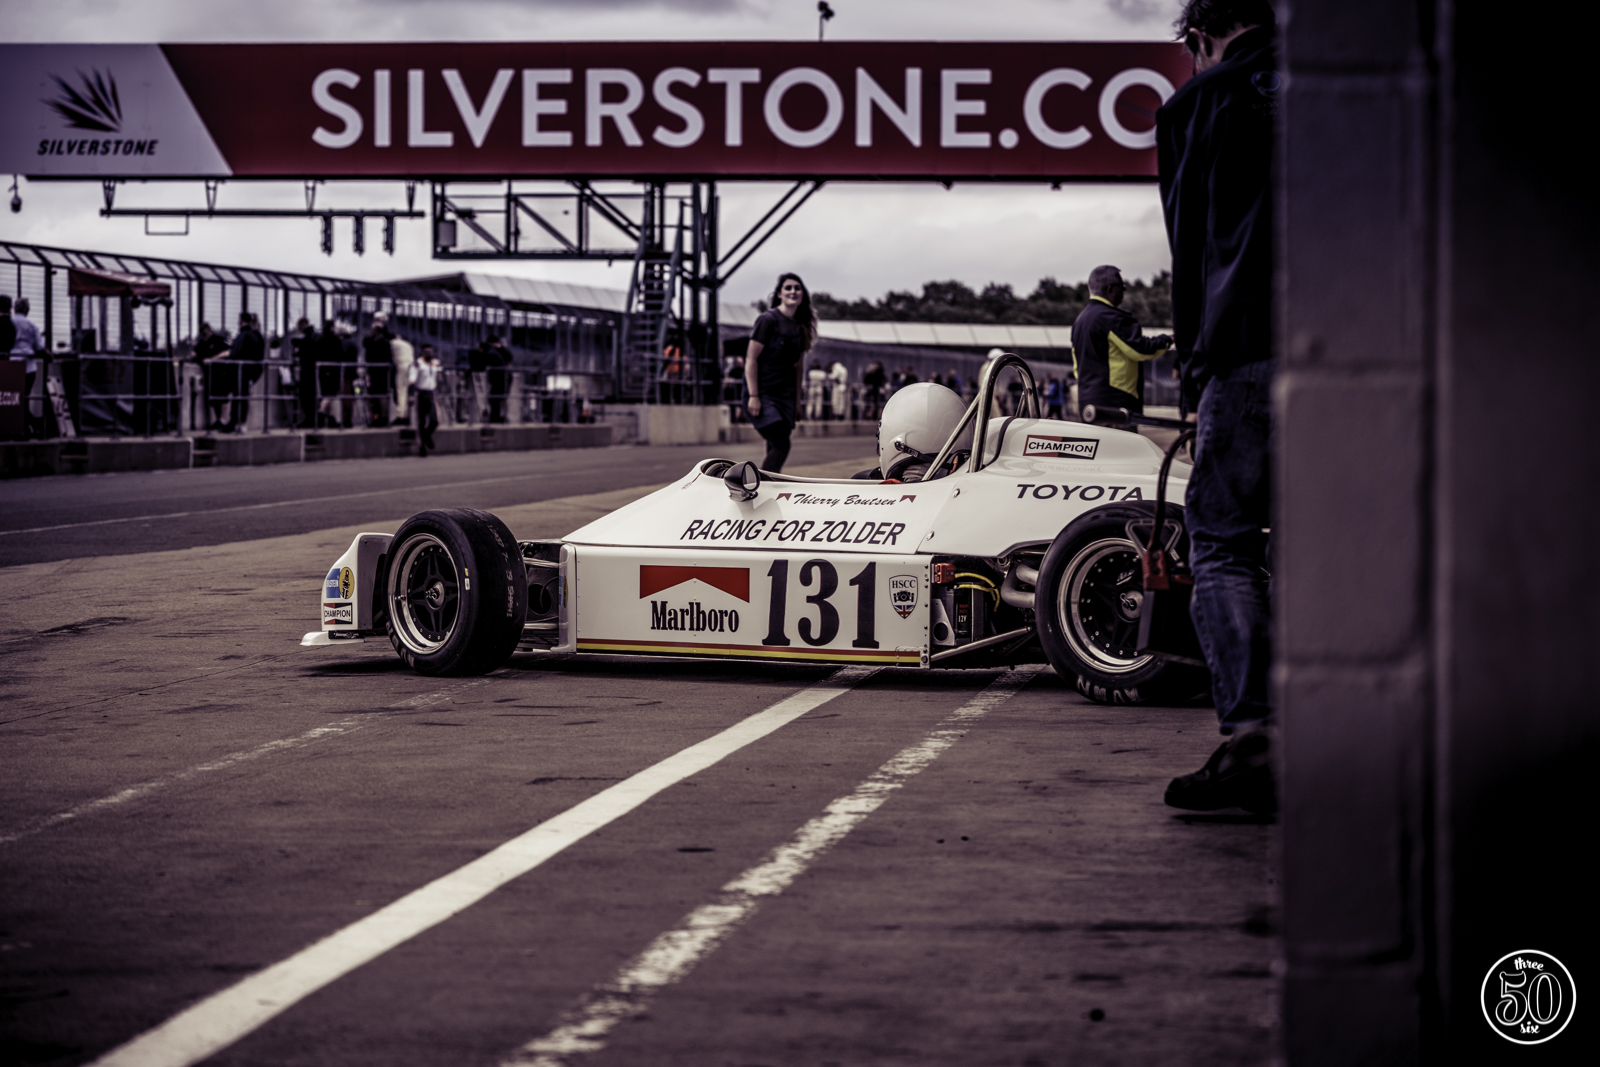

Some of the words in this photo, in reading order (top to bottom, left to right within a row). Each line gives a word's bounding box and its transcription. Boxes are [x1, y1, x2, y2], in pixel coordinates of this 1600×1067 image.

[37, 138, 159, 156] SILVERSTONE
[1028, 441, 1094, 454] CHAMPION
[793, 493, 841, 507] Thierry
[843, 494, 897, 506] Boutsen
[1016, 484, 1143, 501] TOYOTA
[680, 519, 767, 541] RACING
[763, 520, 815, 542] FOR
[810, 520, 906, 546] ZOLDER
[891, 579, 916, 589] HSCC
[761, 558, 880, 649] 131
[324, 609, 351, 618] CHAMPION
[650, 600, 740, 633] Marlboro
